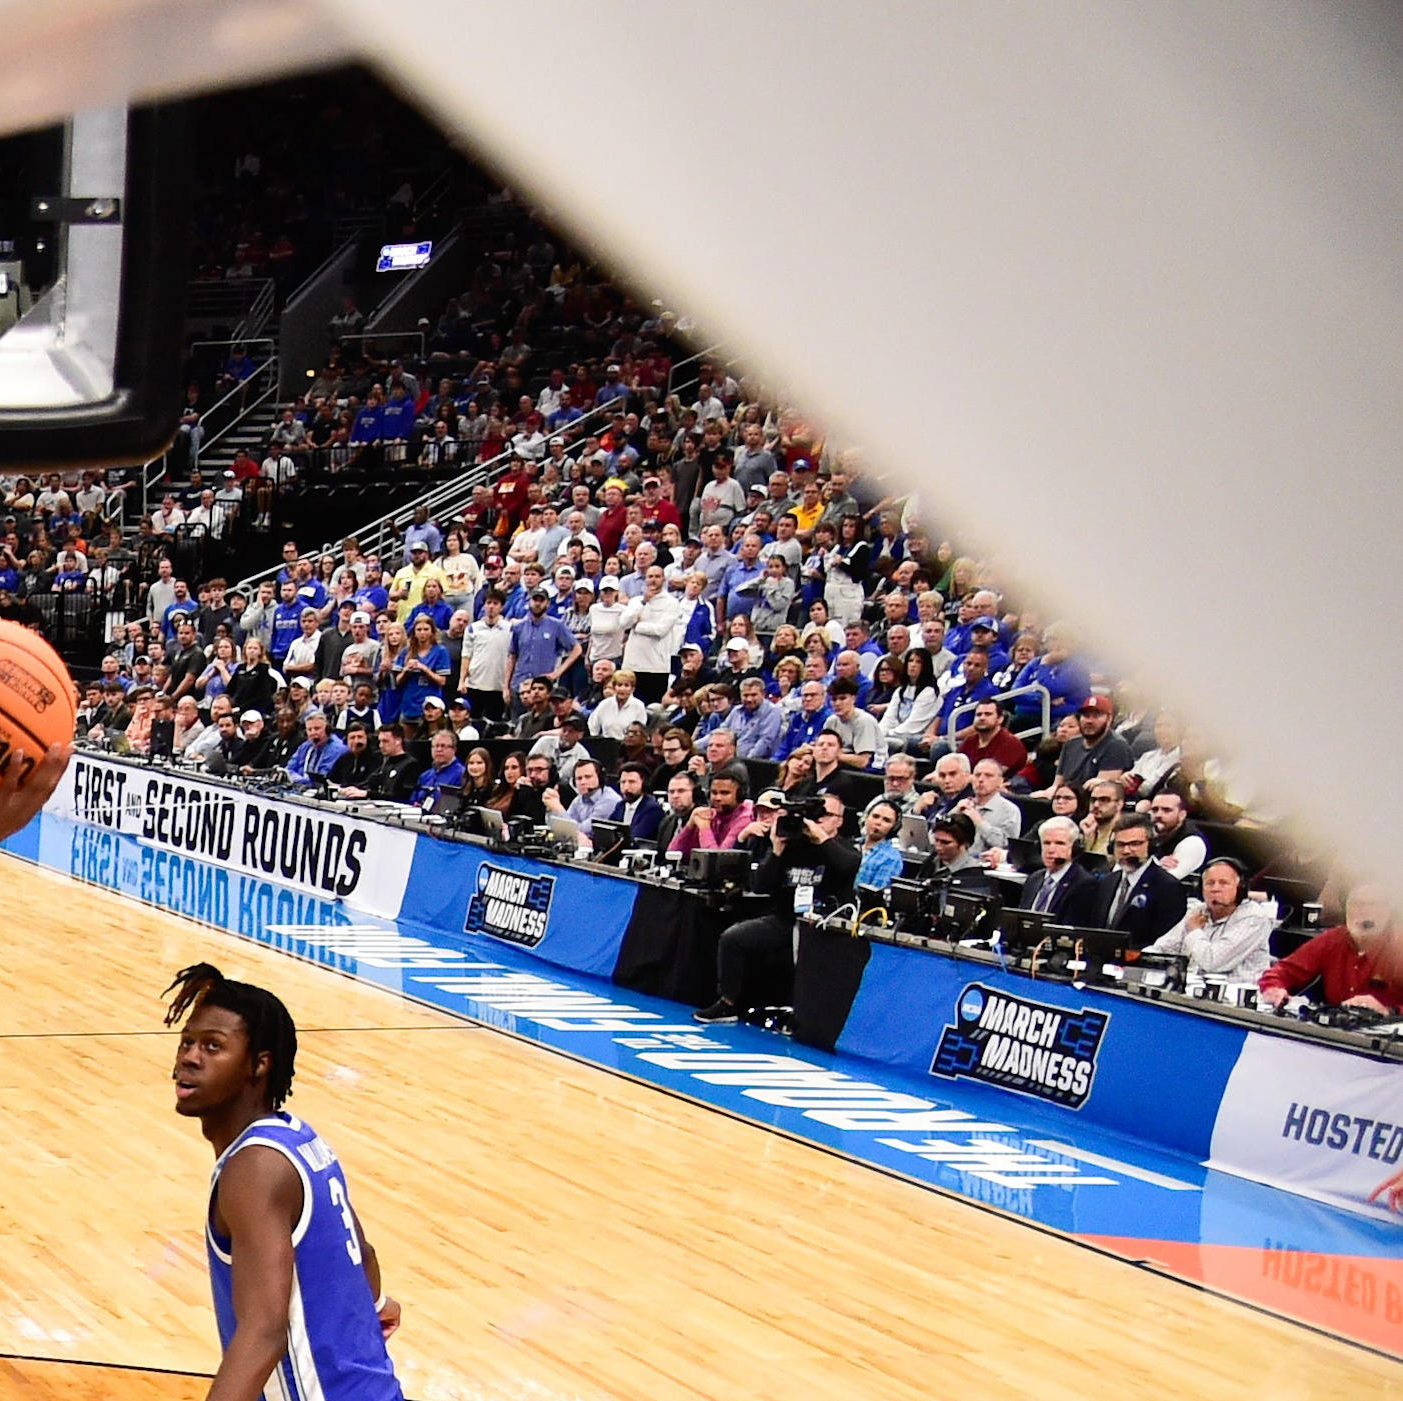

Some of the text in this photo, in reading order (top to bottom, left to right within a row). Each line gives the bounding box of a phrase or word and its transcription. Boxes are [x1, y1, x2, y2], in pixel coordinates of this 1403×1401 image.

[74, 762, 368, 897] FIRST AND SECOND ROUNDS
[484, 870, 531, 906] MARCH
[263, 923, 507, 969] FOUR
[484, 898, 547, 939] MADNESS
[409, 972, 707, 1032] FINAL
[978, 995, 1062, 1049] MARCH
[634, 1051, 1021, 1133] ROAD
[980, 1033, 1092, 1097] MADNESS
[1281, 1102, 1403, 1165] HOSTED
[873, 1136, 1122, 1190] THE
